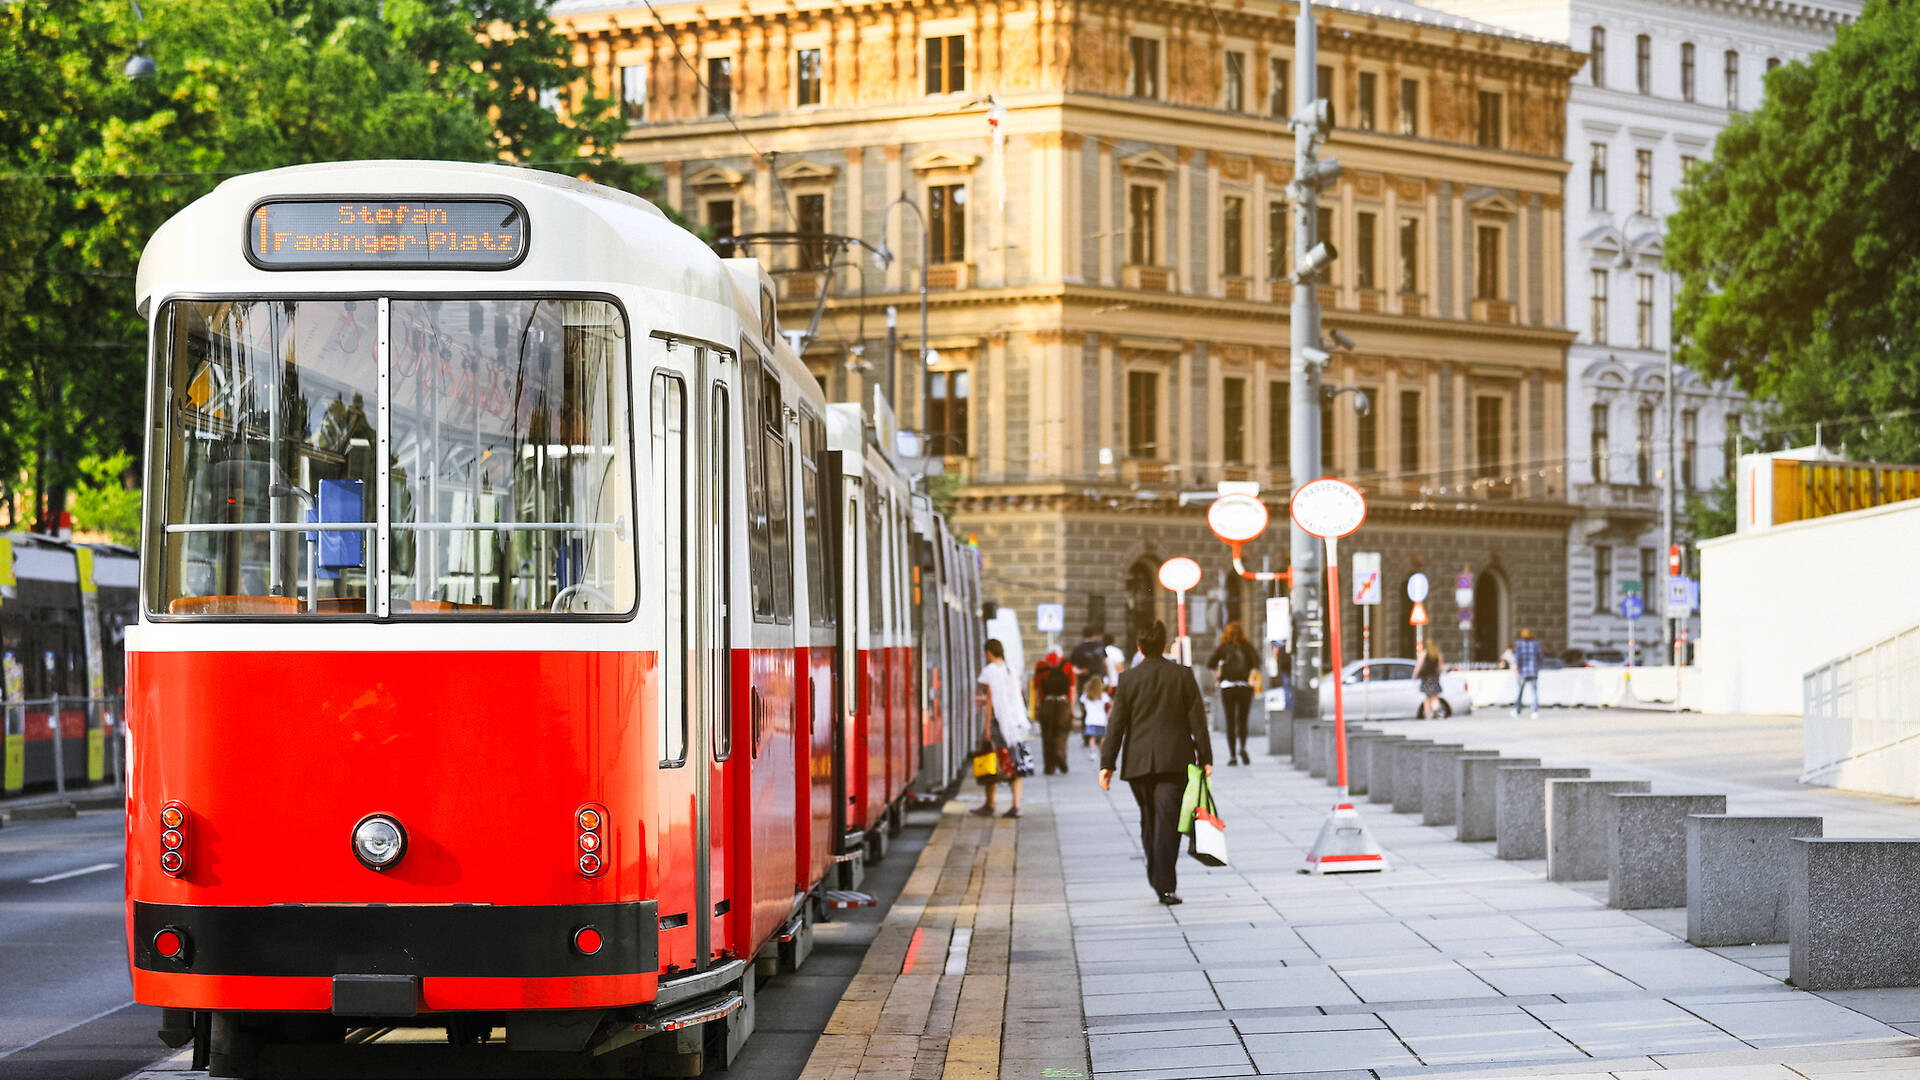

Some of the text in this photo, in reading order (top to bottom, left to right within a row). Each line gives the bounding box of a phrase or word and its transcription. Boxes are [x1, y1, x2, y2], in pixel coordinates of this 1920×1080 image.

[337, 205, 448, 224] Stefan
[255, 205, 268, 254] 1
[274, 231, 513, 254] Fadinger-Platz
